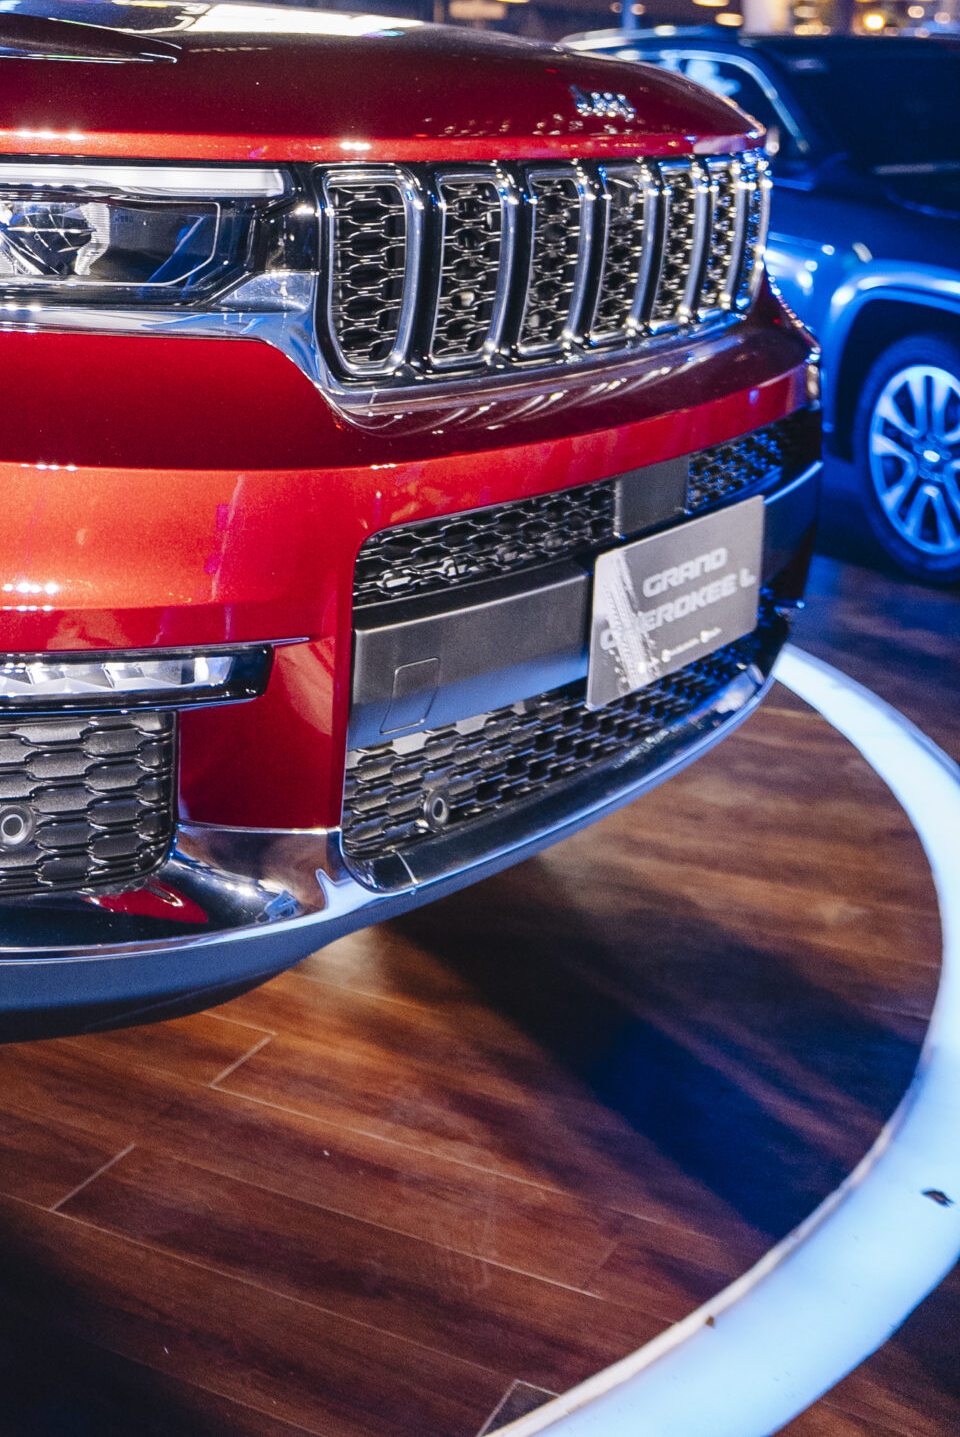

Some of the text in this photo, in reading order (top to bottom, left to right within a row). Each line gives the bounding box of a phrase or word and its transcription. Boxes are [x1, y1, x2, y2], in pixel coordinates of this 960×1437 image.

[642, 547, 728, 598] GRAND
[600, 567, 756, 651] CEROKEE L
